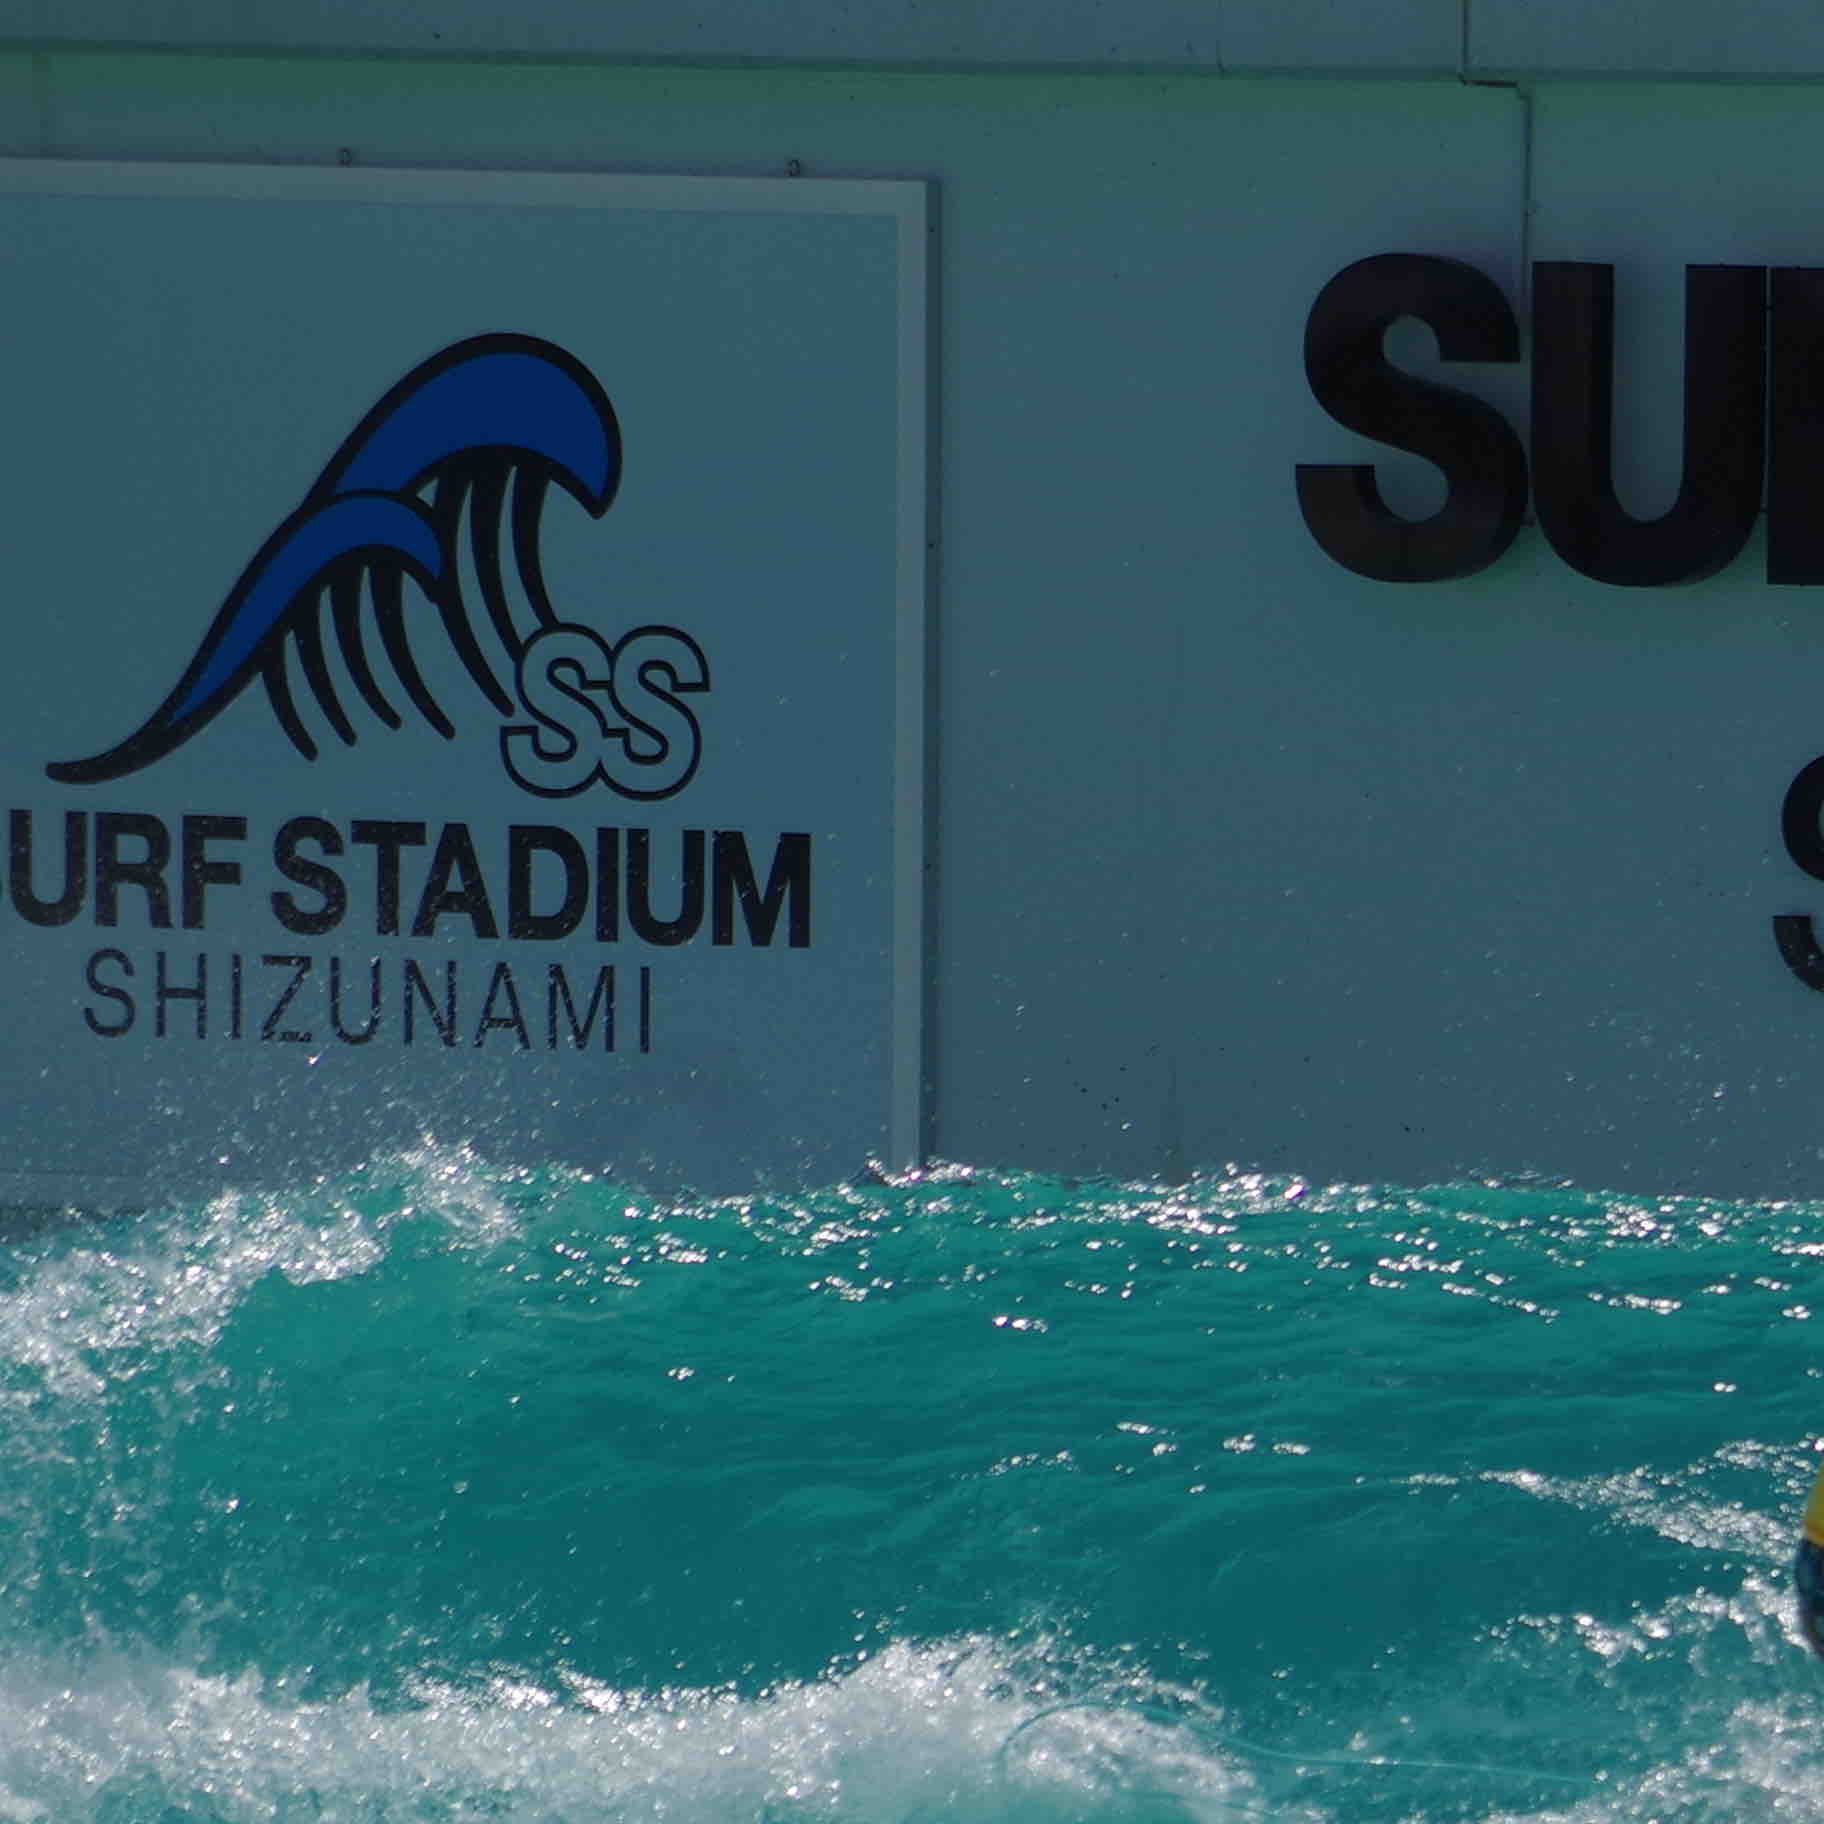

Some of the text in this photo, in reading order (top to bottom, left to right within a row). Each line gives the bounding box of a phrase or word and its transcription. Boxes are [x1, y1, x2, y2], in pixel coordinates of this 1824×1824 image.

[501, 624, 711, 802] SS
[0, 809, 812, 949] URF STADIUM
[84, 947, 651, 1054] SHIZUNAMI
